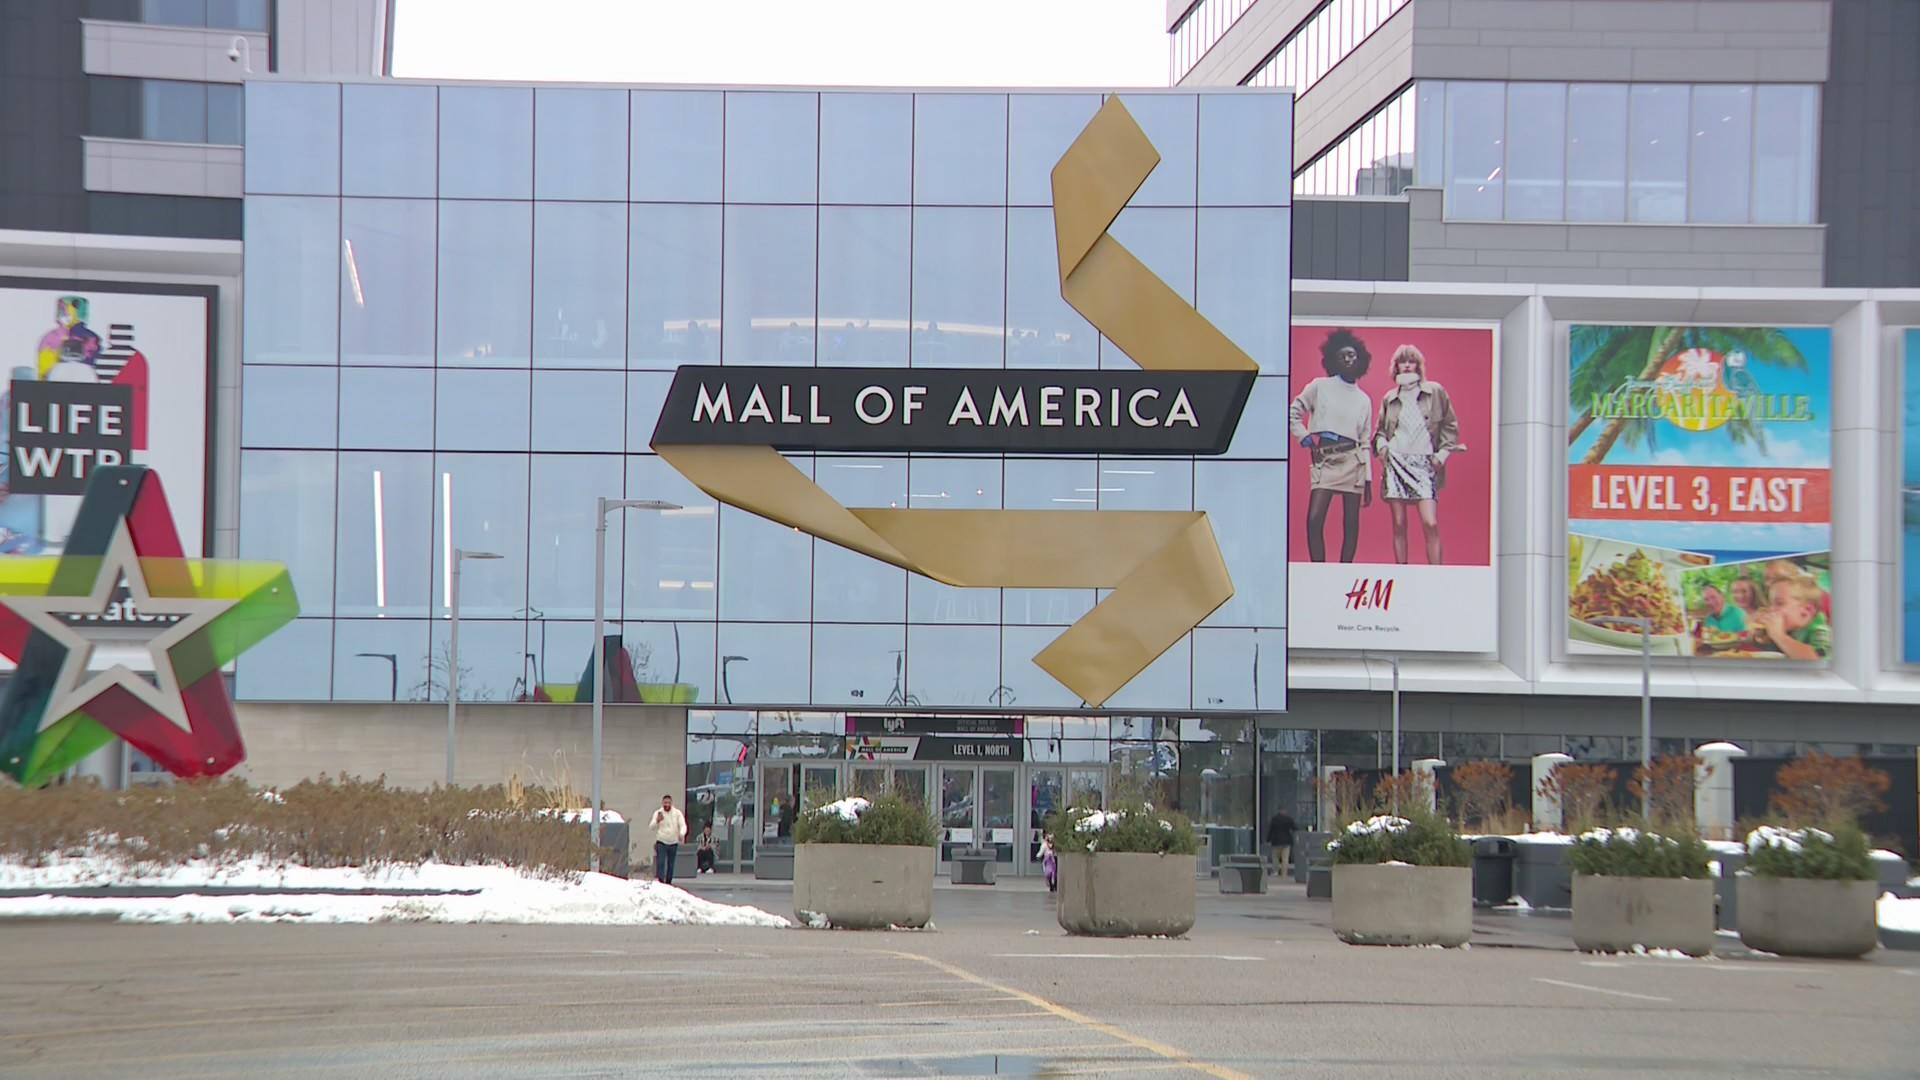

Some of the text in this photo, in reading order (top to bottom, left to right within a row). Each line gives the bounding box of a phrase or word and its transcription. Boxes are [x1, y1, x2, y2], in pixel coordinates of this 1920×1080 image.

[17, 401, 123, 436] LIFE
[692, 382, 1199, 428] MALL OF AMERICA
[1591, 474, 1807, 516] LEVEL 3, EAST
[1344, 578, 1394, 611] H&M
[953, 744, 975, 755] LEVEL
[984, 744, 1009, 756] NORTH
